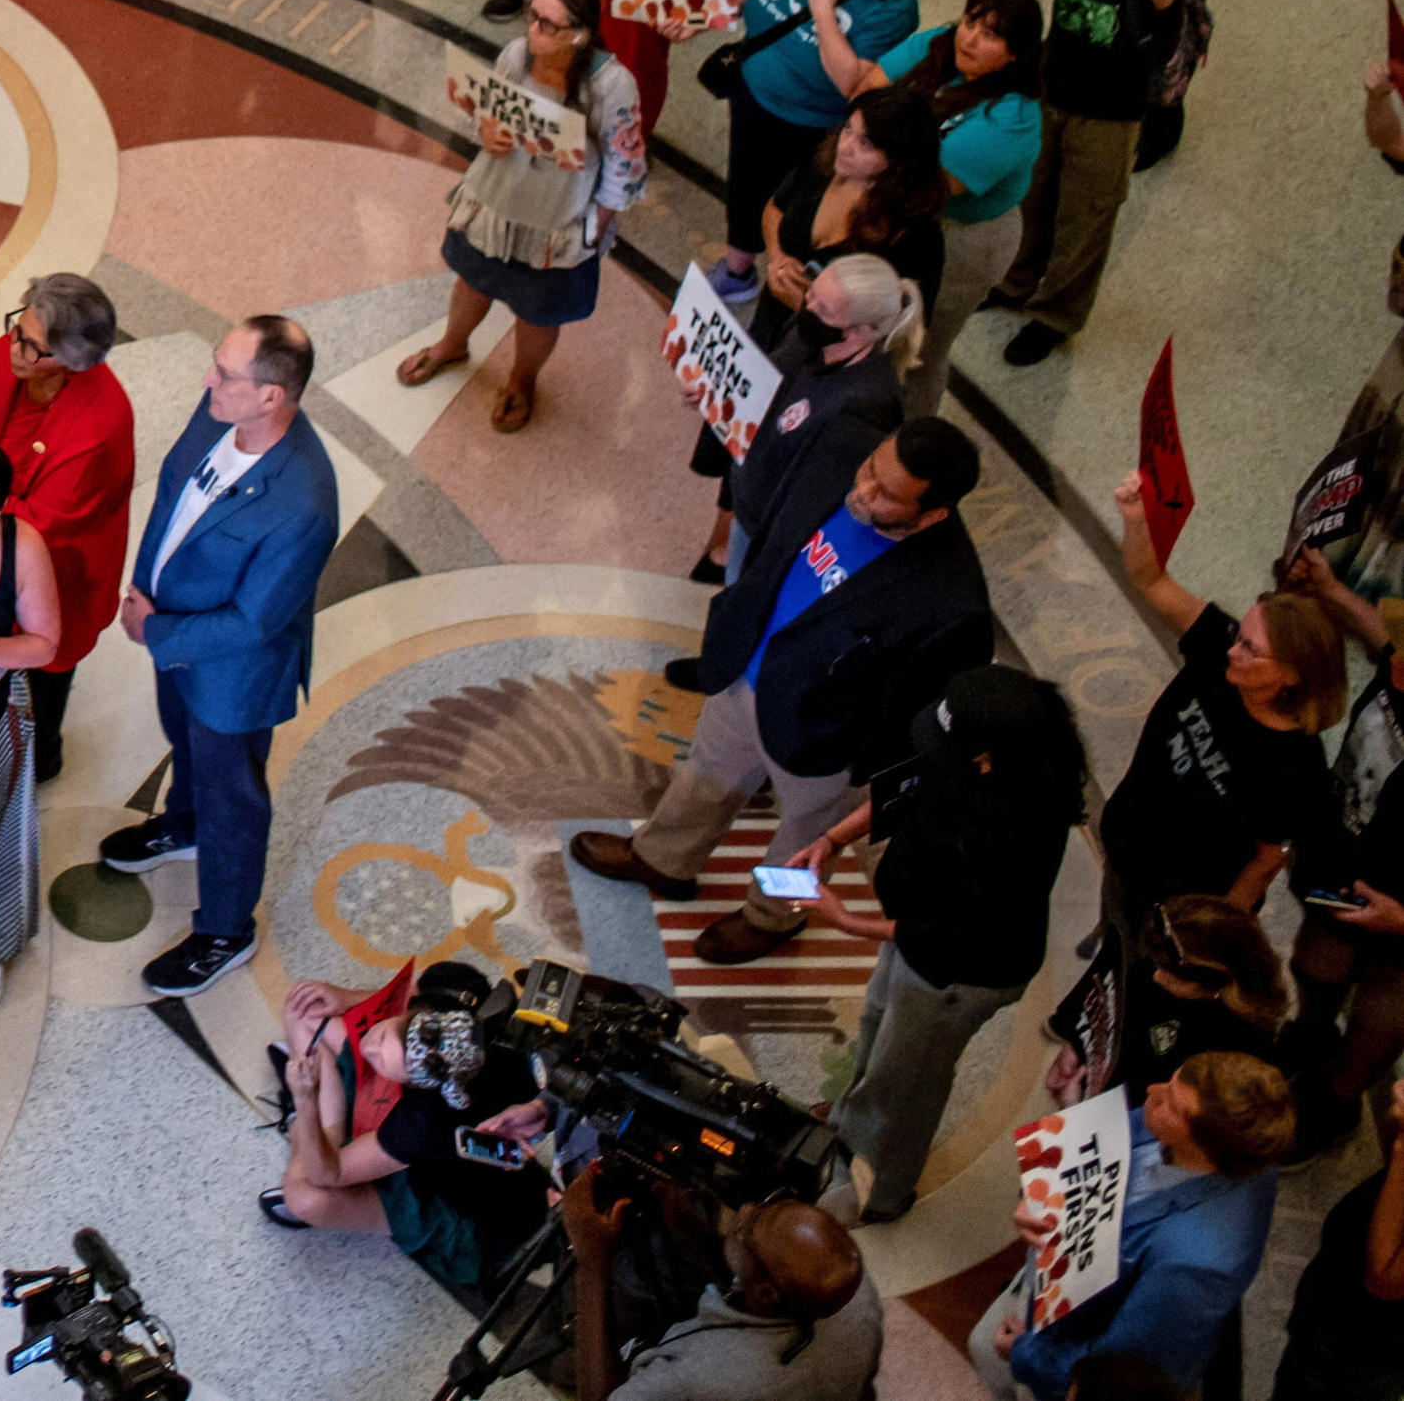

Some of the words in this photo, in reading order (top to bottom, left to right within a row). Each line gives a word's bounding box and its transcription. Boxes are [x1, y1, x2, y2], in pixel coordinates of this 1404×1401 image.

[1060, 1168, 1085, 1261] FIRST
[1077, 1133, 1100, 1272] TEXANS
[1100, 1160, 1122, 1222] PUT
